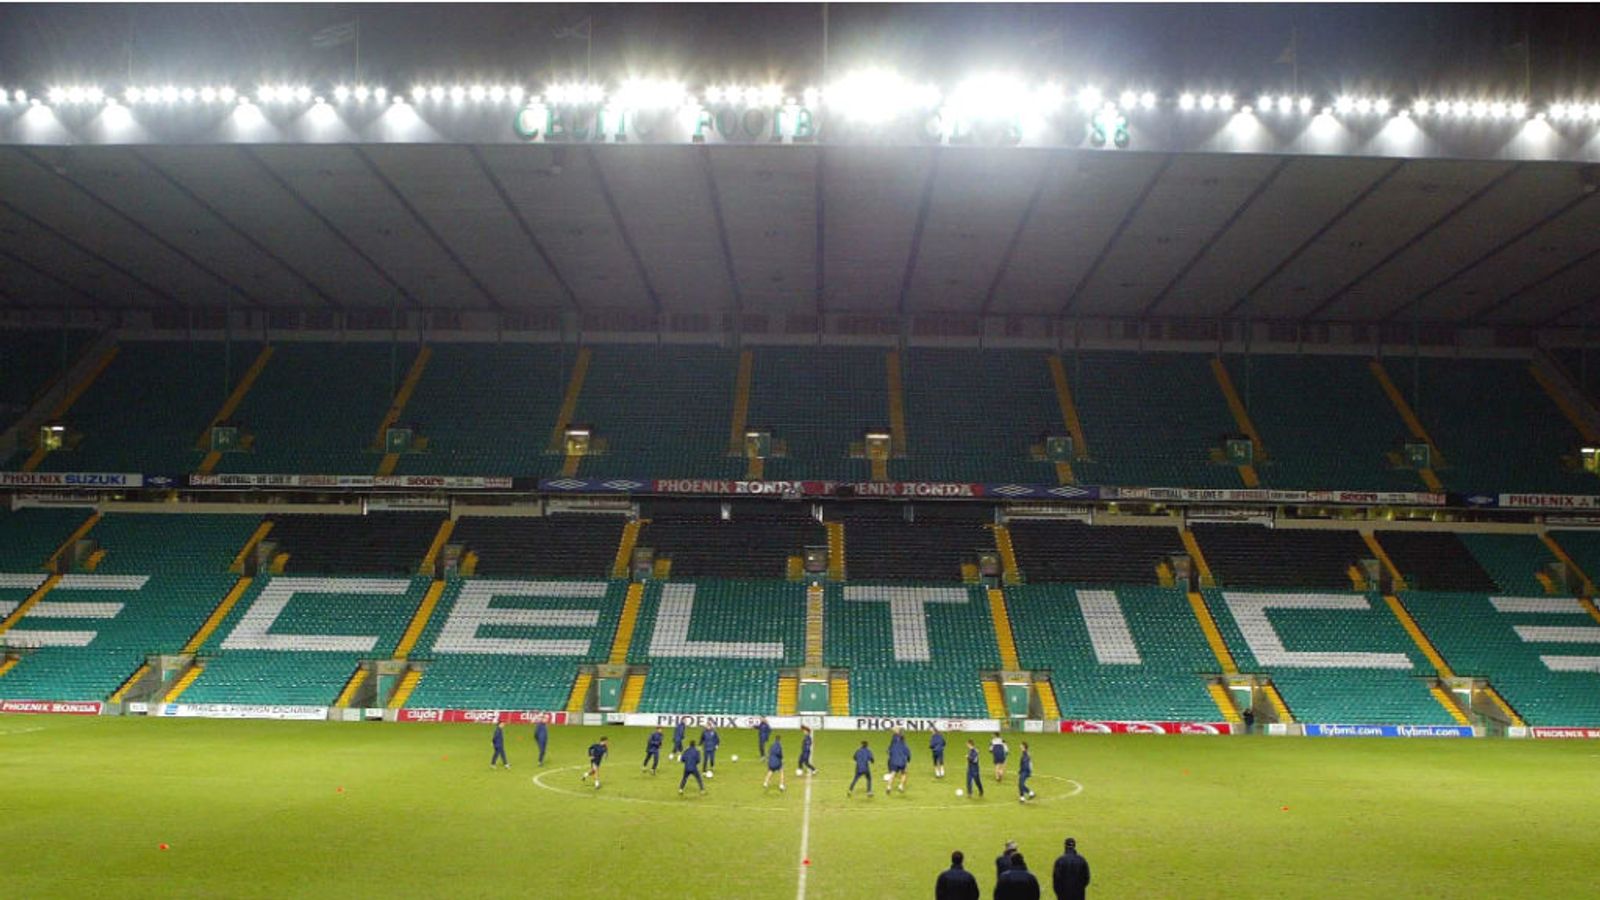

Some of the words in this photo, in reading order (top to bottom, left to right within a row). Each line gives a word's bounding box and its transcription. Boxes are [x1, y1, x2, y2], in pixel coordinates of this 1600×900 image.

[2, 474, 62, 484] PHOENIX
[65, 474, 126, 485] SUZUKI
[657, 480, 729, 493] PHOENIX
[734, 480, 805, 495] HONDA
[823, 482, 896, 495] PENIX
[902, 482, 974, 496] HONDA
[1509, 495, 1574, 506] PHOENIX
[220, 576, 1414, 669] CELTIC
[2, 701, 49, 711] PHOENIX
[51, 702, 97, 713] HONDA
[657, 715, 738, 728] PHOENIX
[857, 718, 938, 731] PHOENIX
[1318, 724, 1382, 736] flybmi.com
[1397, 725, 1460, 737] flybmi.com
